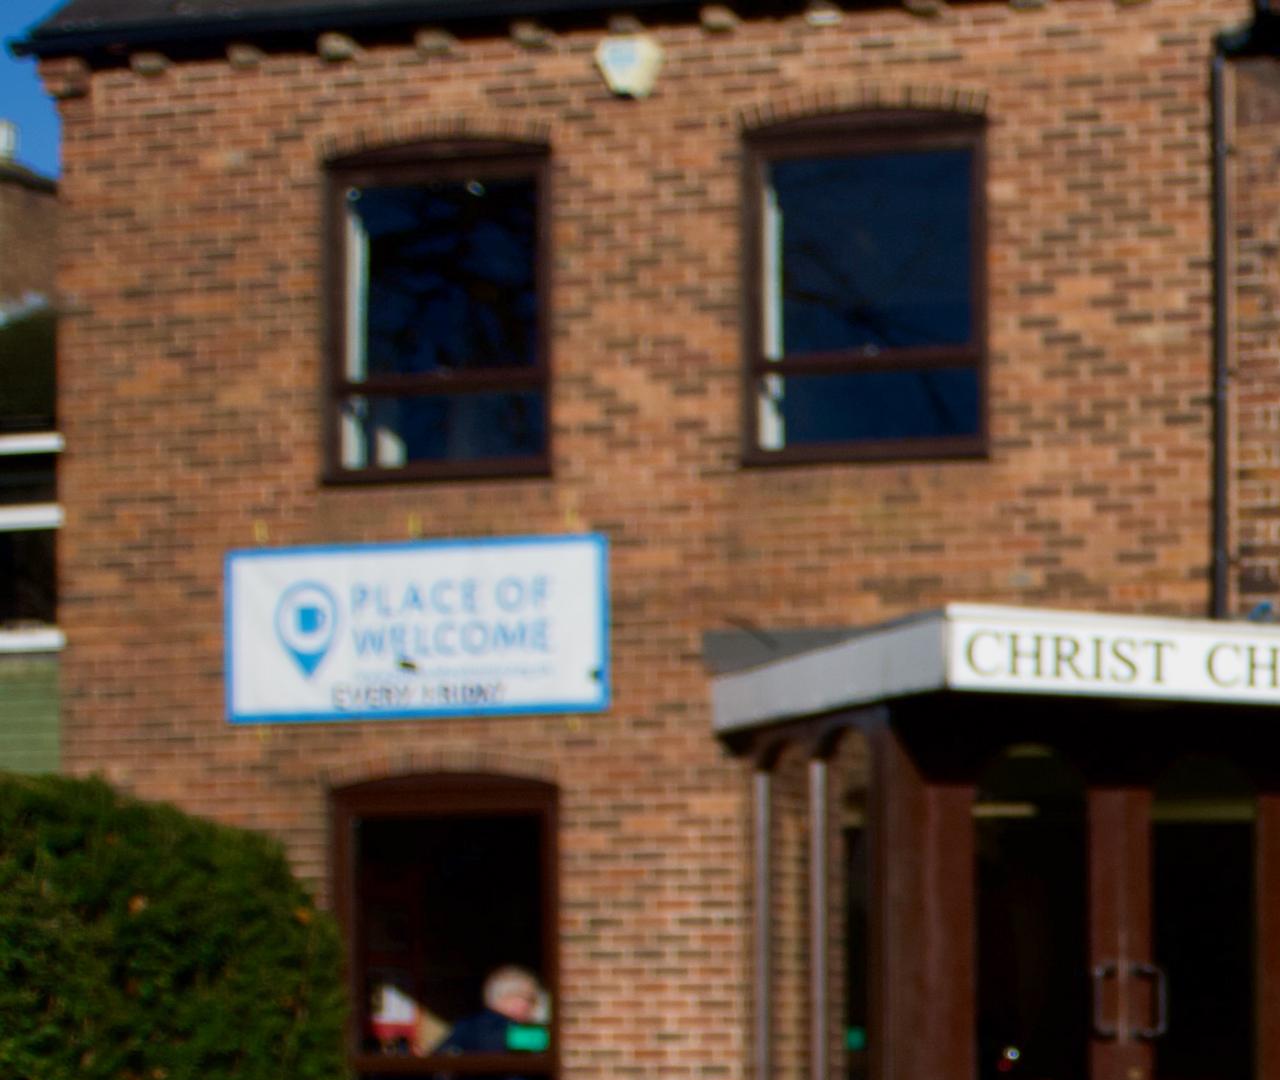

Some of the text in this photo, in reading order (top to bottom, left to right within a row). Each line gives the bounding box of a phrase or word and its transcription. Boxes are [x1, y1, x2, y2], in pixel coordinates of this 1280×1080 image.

[350, 574, 552, 616] PLACE OF
[351, 619, 552, 657] WELCOME
[966, 631, 1176, 685] CHRIST
